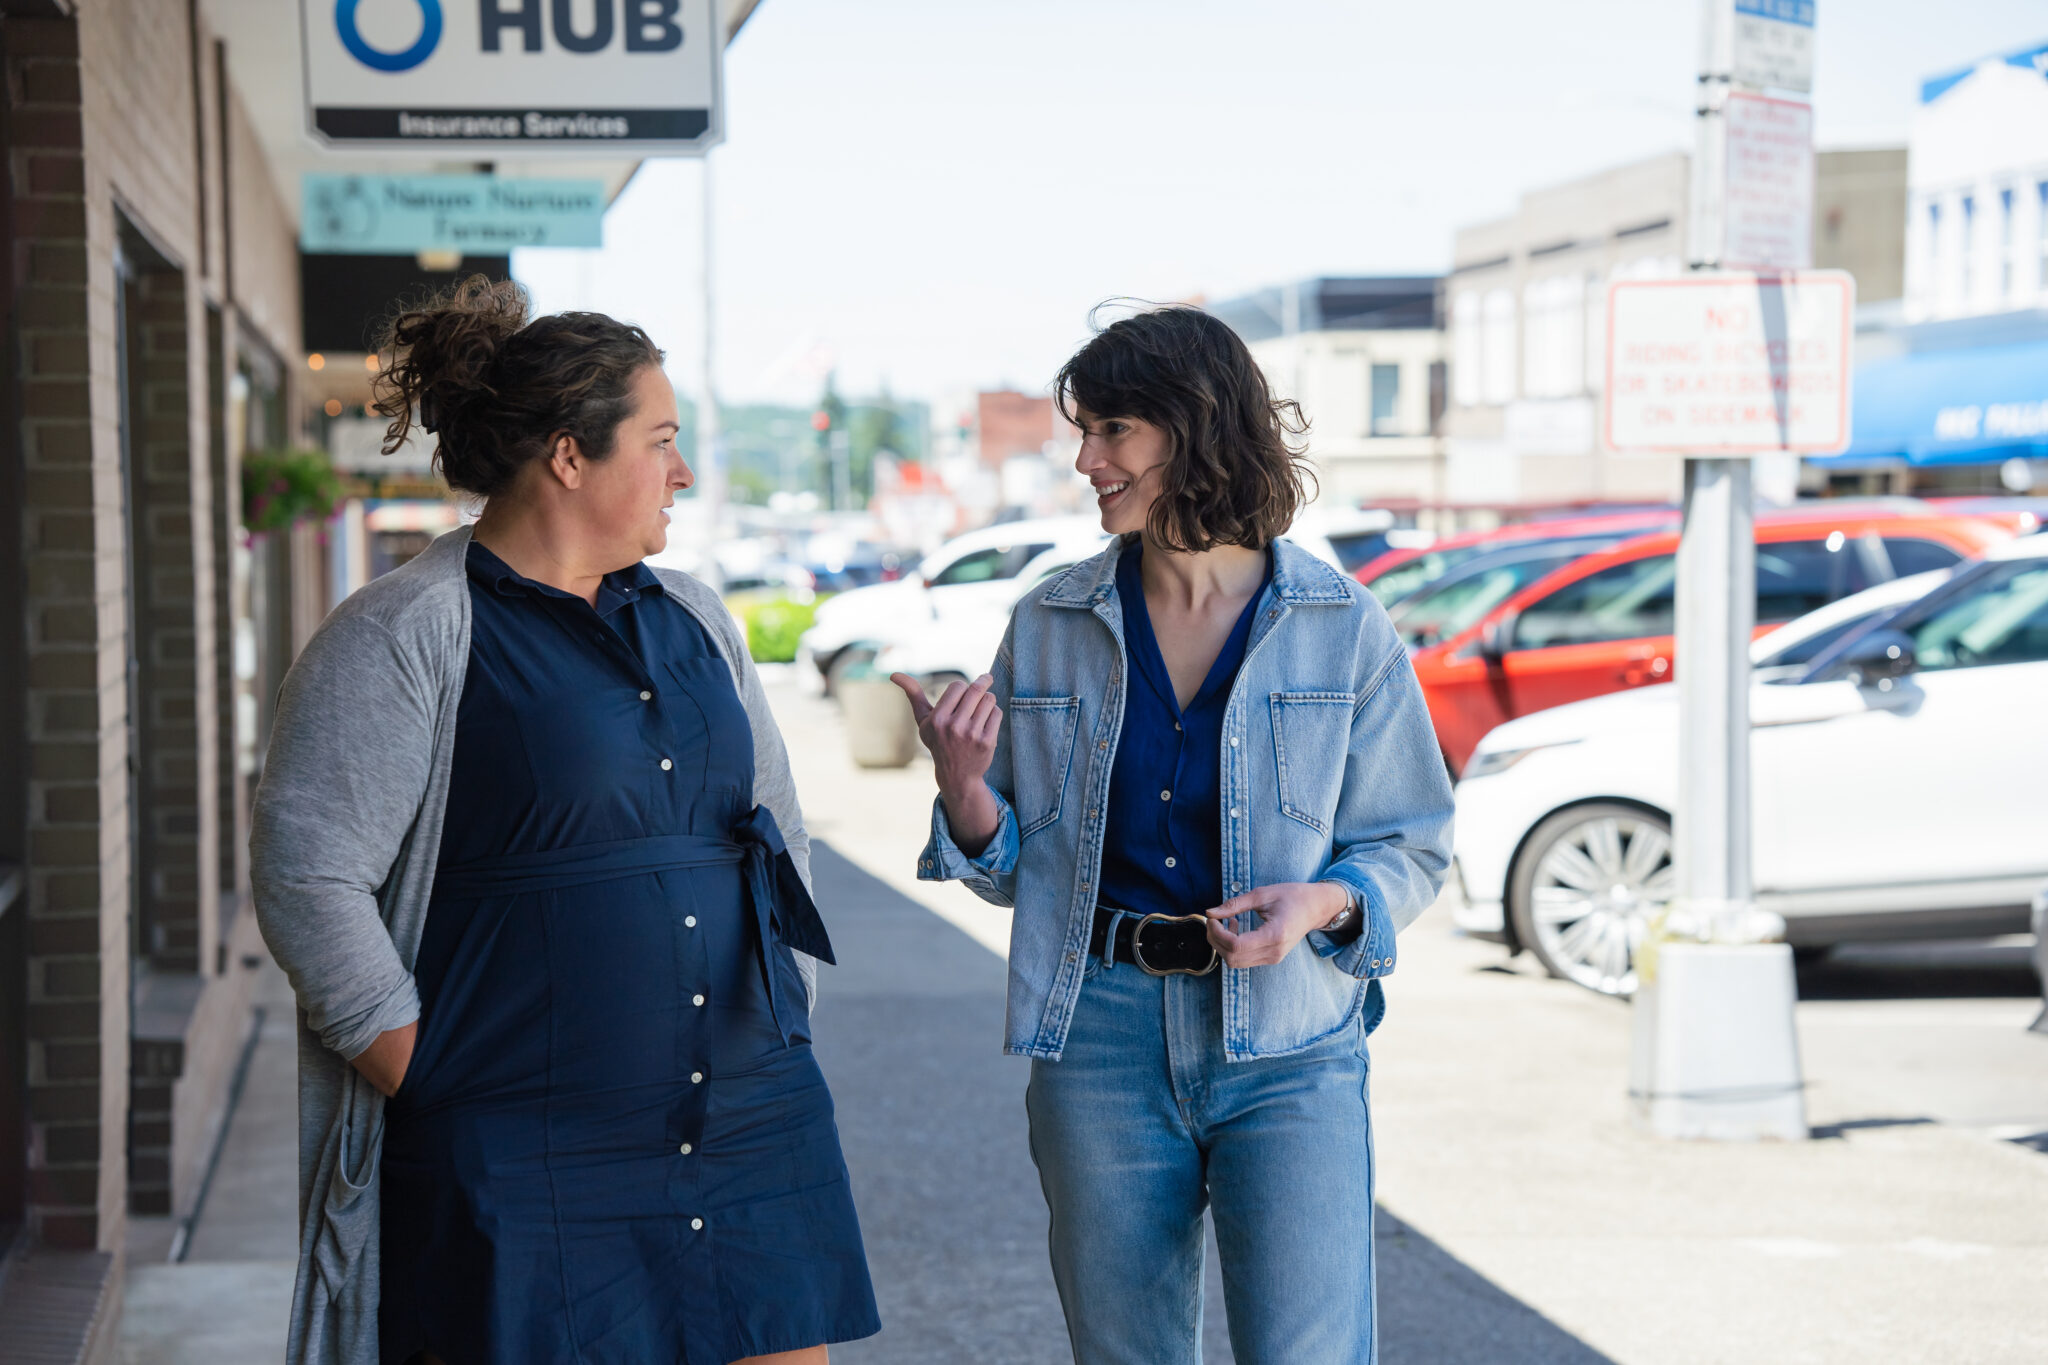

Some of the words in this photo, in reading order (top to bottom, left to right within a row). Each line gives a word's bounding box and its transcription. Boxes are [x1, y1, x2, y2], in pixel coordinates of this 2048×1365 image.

[478, 0, 684, 54] HUB
[399, 112, 520, 137] Insurance
[524, 112, 629, 137] Services
[1705, 307, 1748, 331] NO
